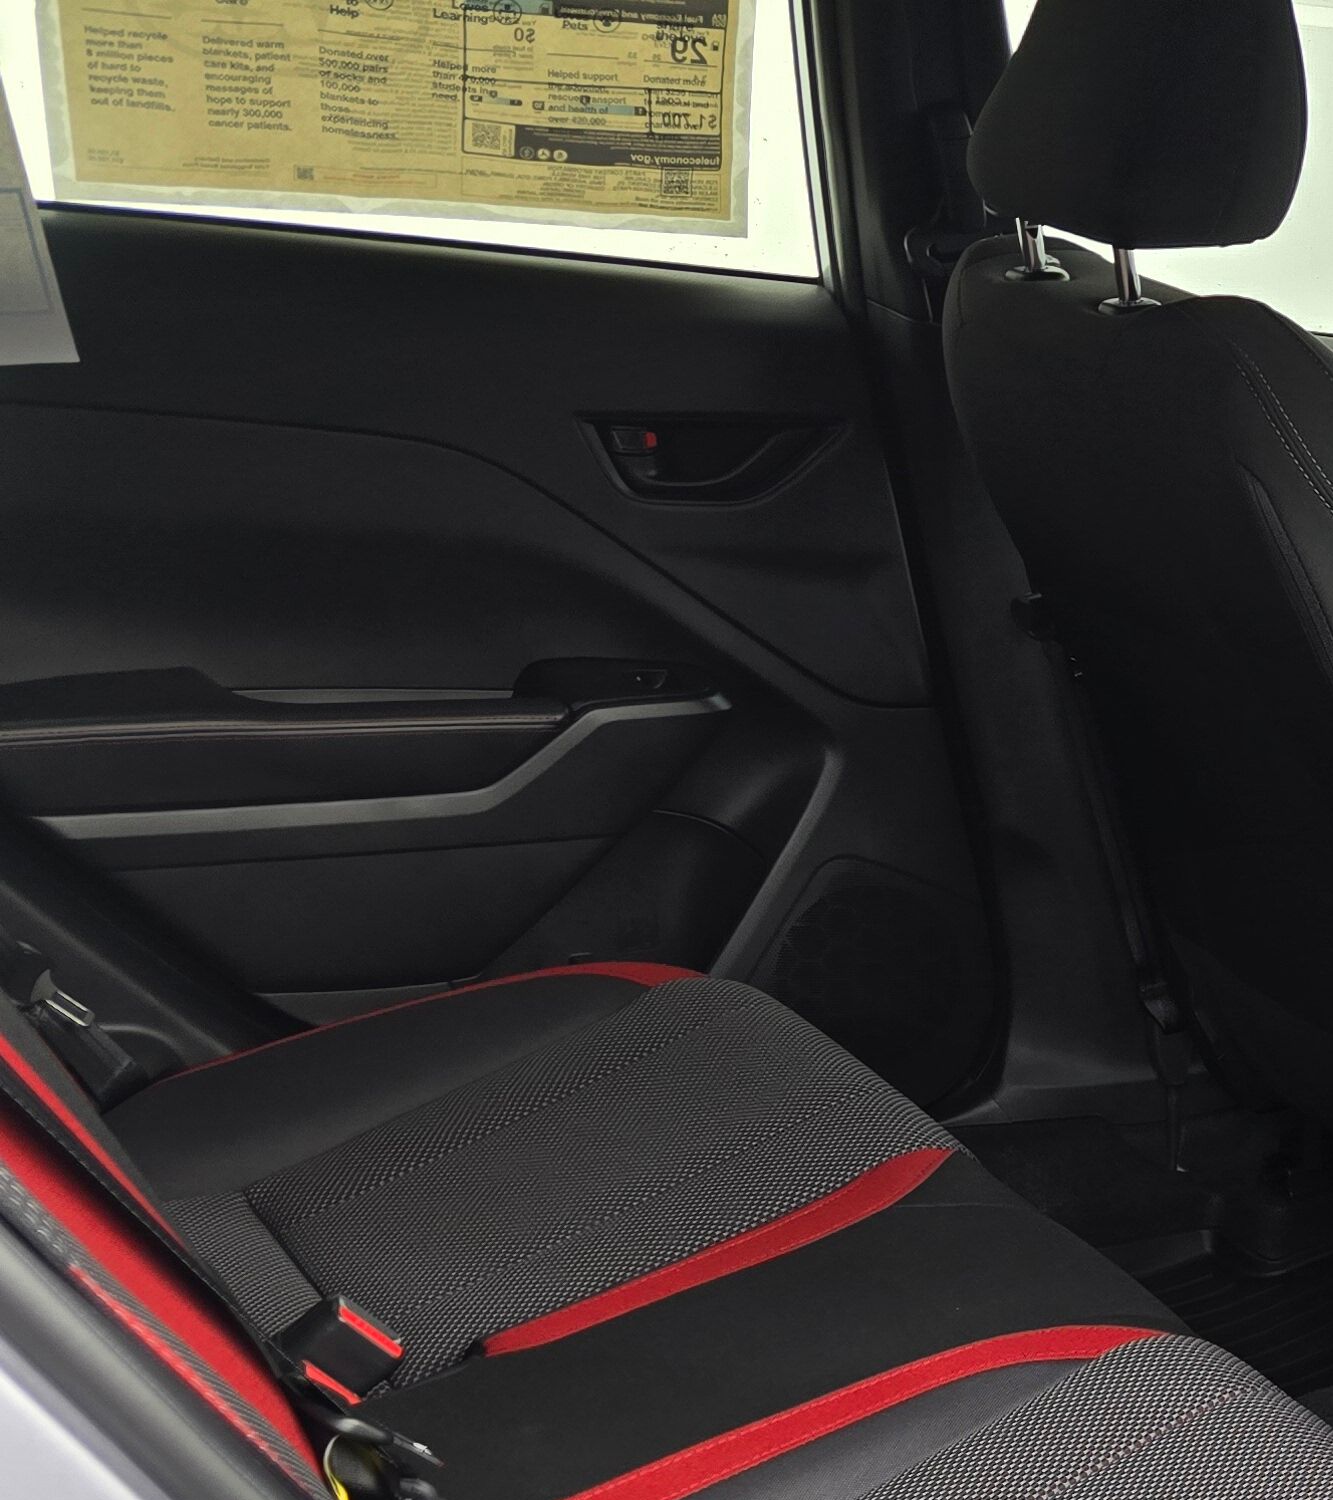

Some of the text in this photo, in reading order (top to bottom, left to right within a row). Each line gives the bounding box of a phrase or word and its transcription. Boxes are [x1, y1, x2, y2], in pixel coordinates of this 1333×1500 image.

[329, 4, 360, 20] Help
[562, 20, 588, 31] Pets
[83, 25, 169, 42] Helped recycle
[85, 38, 143, 50] more than
[202, 35, 285, 50] Delivered warm
[95, 49, 135, 61] million
[137, 52, 174, 65] pieces
[202, 47, 292, 63] blankets, patient
[318, 46, 390, 64] Donated over
[87, 60, 98, 70] of
[100, 61, 128, 72] hard
[204, 60, 226, 69] care
[255, 63, 275, 72] and
[318, 58, 388, 75] 500,000 pairs
[472, 65, 497, 73] more
[88, 73, 129, 85] recycle
[204, 72, 272, 86] encouraging
[318, 69, 388, 84] of socks and
[547, 69, 618, 81] Helped support
[643, 74, 681, 85] Donated
[89, 85, 166, 99] keeping them
[206, 83, 274, 96] messages of
[320, 80, 361, 94] 100,000
[91, 97, 109, 107] out
[112, 98, 123, 107] of
[206, 94, 292, 110] hope to support
[320, 91, 379, 106] blankets to
[207, 107, 240, 118] nearly
[320, 102, 349, 114] those
[548, 103, 609, 115] and health of
[208, 119, 292, 133] cancer patients.
[321, 114, 389, 130] experiencing
